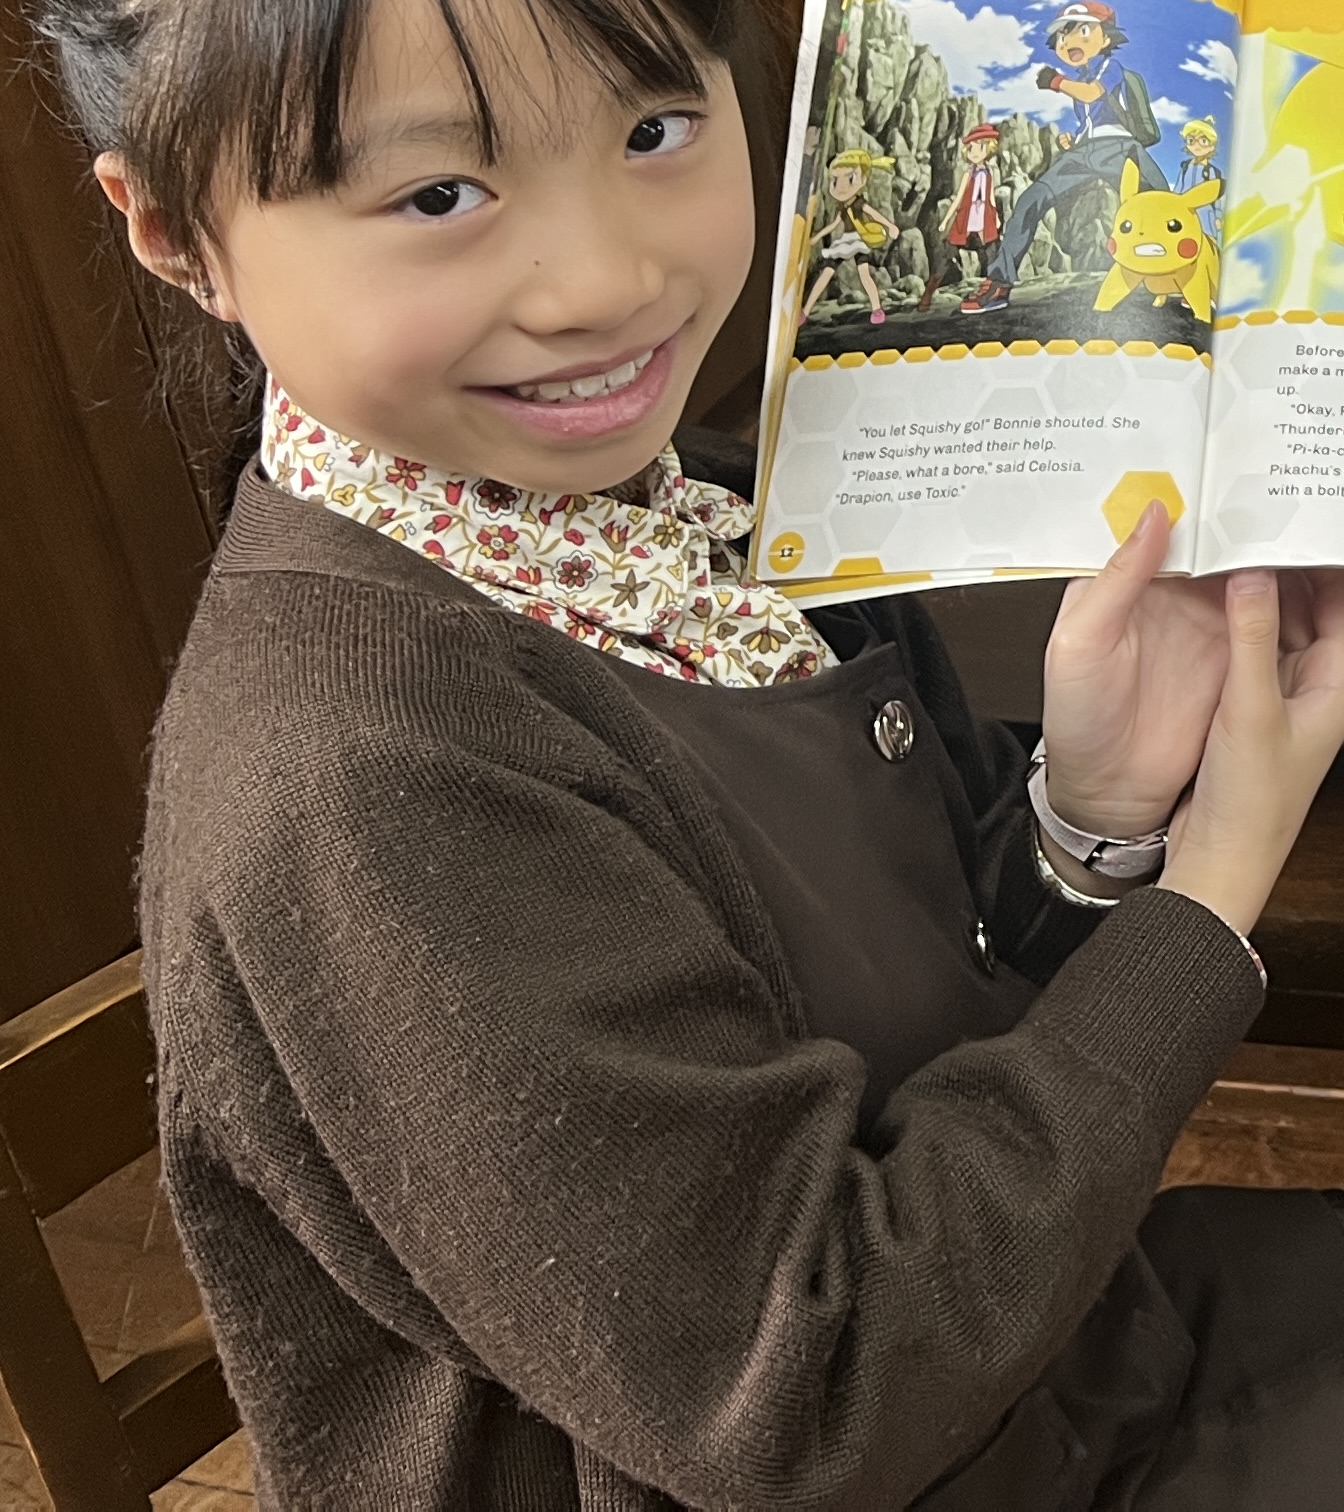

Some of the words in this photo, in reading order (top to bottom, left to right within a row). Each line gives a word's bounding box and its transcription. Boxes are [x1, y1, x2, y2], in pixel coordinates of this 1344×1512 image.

[1296, 345, 1344, 357] Before
[1279, 364, 1318, 375] make
[1322, 368, 1331, 376] a
[1277, 386, 1300, 397] up.
[1291, 403, 1335, 417] "Okay,
[859, 427, 886, 438] "You
[890, 425, 906, 437] let
[909, 420, 961, 437] Squishy
[964, 418, 990, 434] go!"
[993, 417, 1041, 430] Bonnie
[1045, 416, 1108, 429] shouted.
[1112, 416, 1140, 429] She
[842, 449, 875, 461] knew
[878, 444, 930, 460] Squishy
[933, 441, 982, 455] wanted
[986, 438, 1020, 452] their
[1023, 438, 1056, 452] help.
[852, 469, 902, 481] "Please,
[906, 466, 937, 479] what
[941, 467, 950, 477] a
[953, 461, 993, 476] bore,"
[995, 461, 1024, 474] said
[1028, 460, 1085, 473] Celosia.
[1269, 464, 1341, 476] Pikachu's
[835, 490, 894, 505] "Drapion,
[898, 489, 921, 501] use
[926, 485, 966, 500] Toxic."
[1268, 484, 1299, 496] with
[1304, 486, 1313, 496] a
[1318, 484, 1344, 497] bolt
[780, 548, 794, 557] 12
